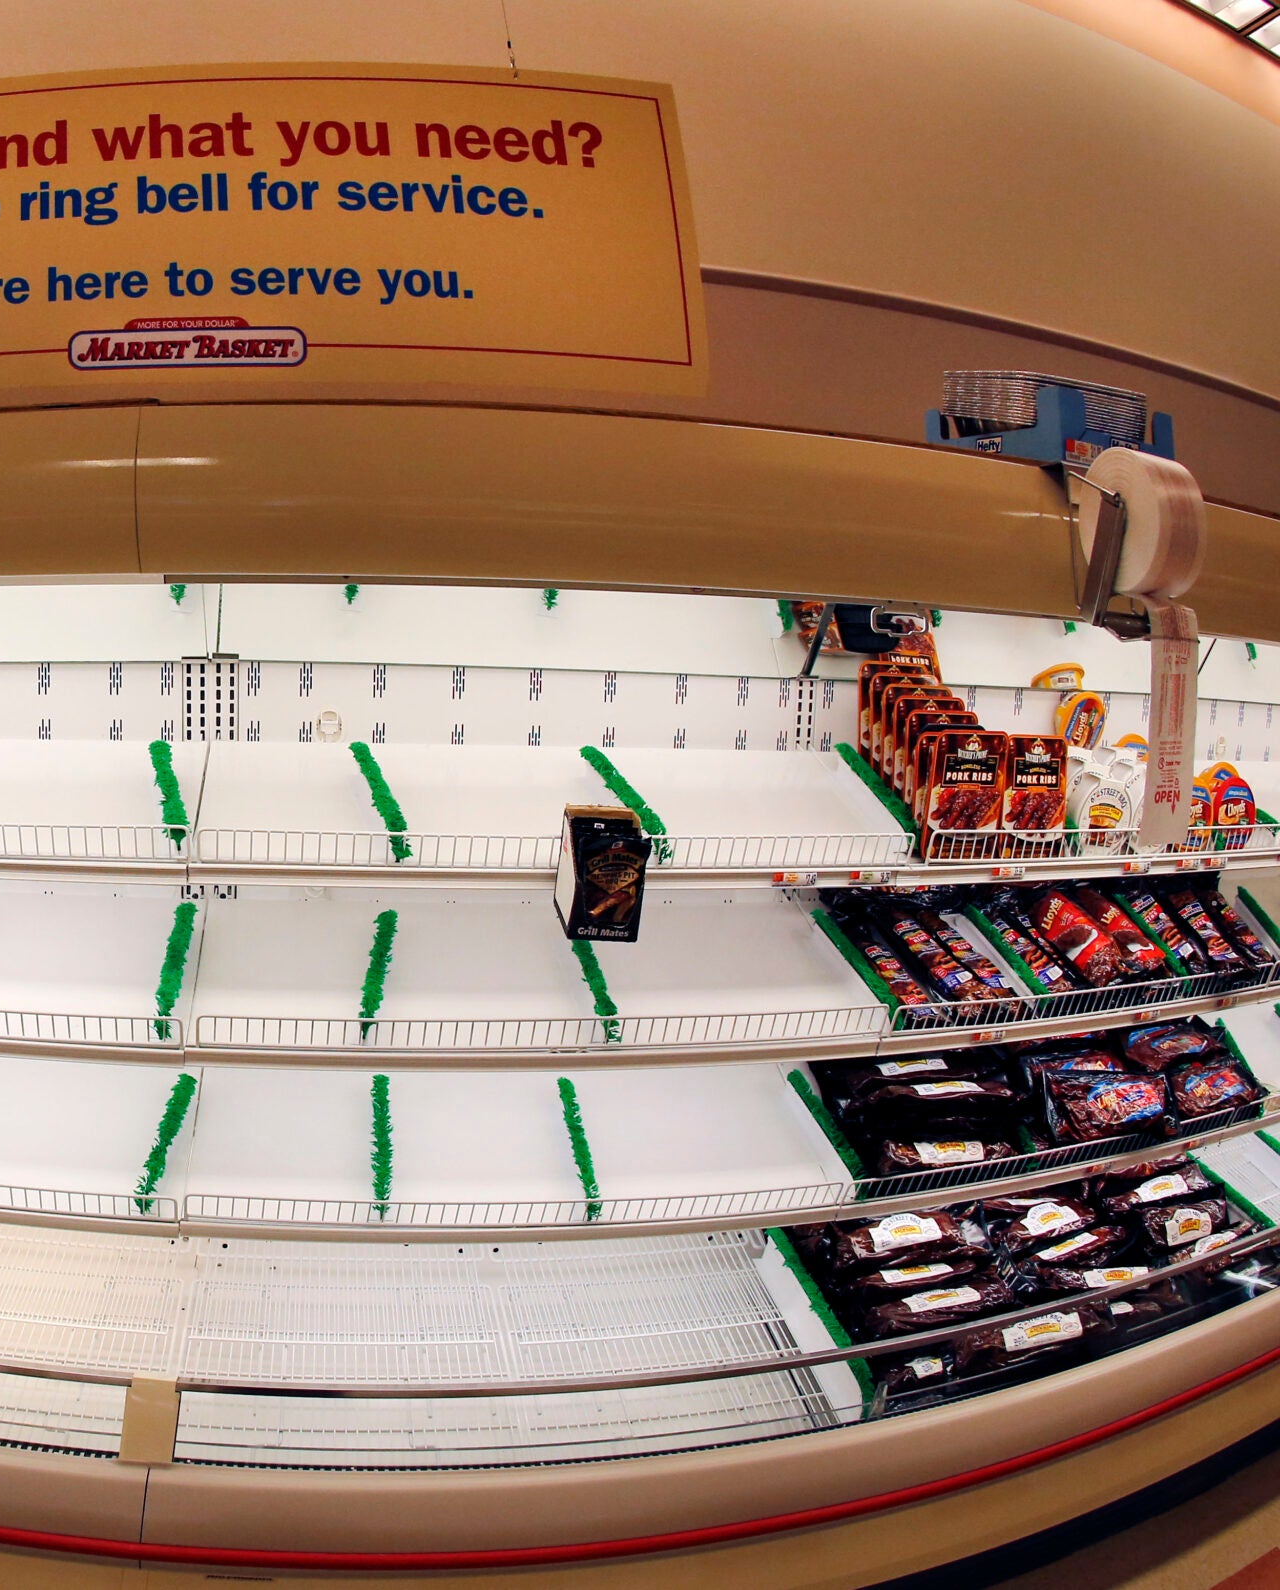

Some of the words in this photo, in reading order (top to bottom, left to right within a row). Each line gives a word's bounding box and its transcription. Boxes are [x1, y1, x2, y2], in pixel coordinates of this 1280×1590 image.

[91, 111, 255, 162] what
[275, 120, 391, 168] you
[414, 119, 603, 169] need?
[20, 181, 119, 226] ring
[137, 173, 229, 214] bell
[248, 171, 320, 211] for
[337, 174, 544, 218] service.
[47, 266, 149, 302] here
[164, 262, 214, 297] to
[230, 267, 361, 297] serve
[377, 269, 474, 305] you.
[162, 320, 179, 329] FOR
[180, 319, 203, 328] YOUR
[77, 337, 191, 362] MARKET
[192, 335, 295, 359] BASKET
[977, 439, 1000, 452] Hefty
[946, 772, 970, 781] PORK
[971, 772, 993, 781] RIBS
[1016, 775, 1038, 784] PORK
[1039, 775, 1057, 784] RIBS
[1154, 790, 1180, 803] OPEN
[577, 927, 598, 937] Grill
[600, 928, 629, 938] Mates
